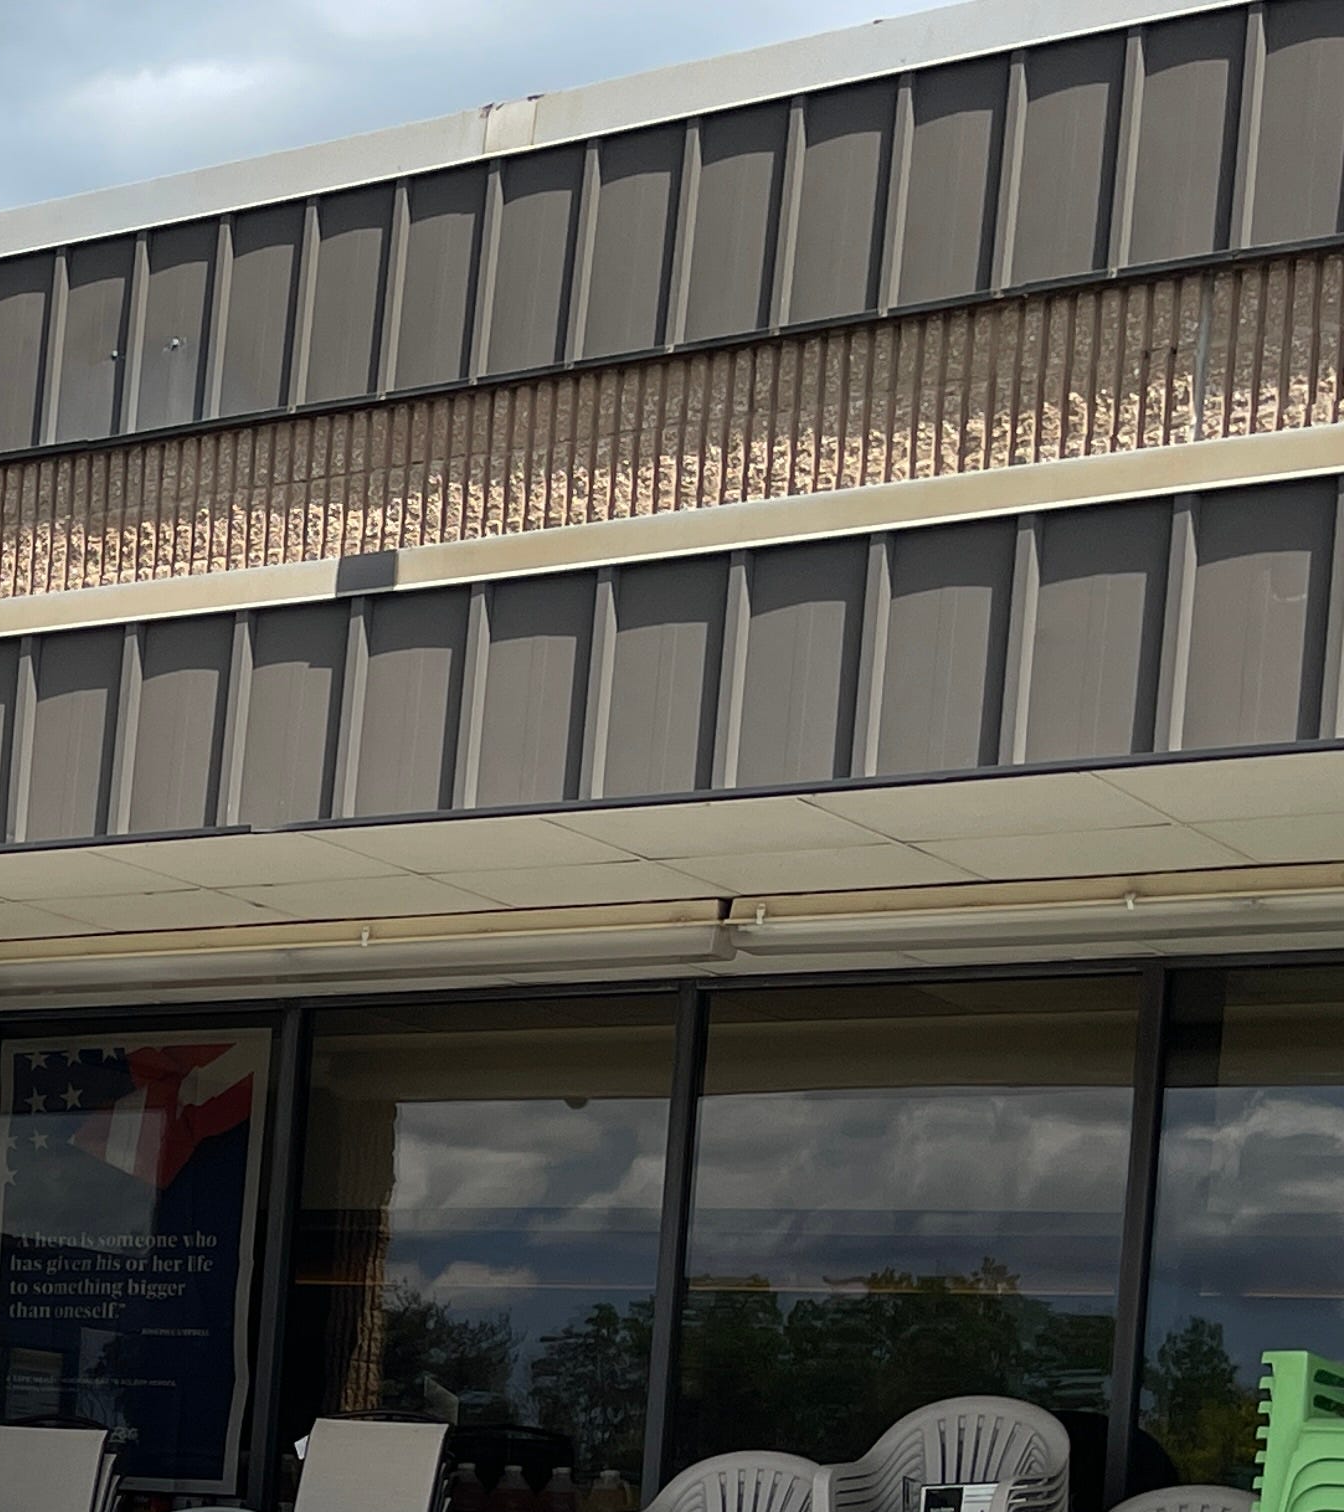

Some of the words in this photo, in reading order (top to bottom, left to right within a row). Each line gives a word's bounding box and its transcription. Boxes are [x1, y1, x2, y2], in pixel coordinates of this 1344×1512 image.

[81, 1232, 95, 1248] is
[97, 1235, 177, 1249] someone
[183, 1231, 217, 1249] who
[10, 1254, 43, 1271] has
[46, 1255, 92, 1275] given
[96, 1254, 120, 1271] his
[126, 1257, 147, 1272] or
[152, 1254, 183, 1272] her
[187, 1255, 214, 1272] life
[9, 1280, 28, 1296] to
[32, 1278, 123, 1299] something
[127, 1278, 186, 1300] bigger
[9, 1301, 51, 1319] than
